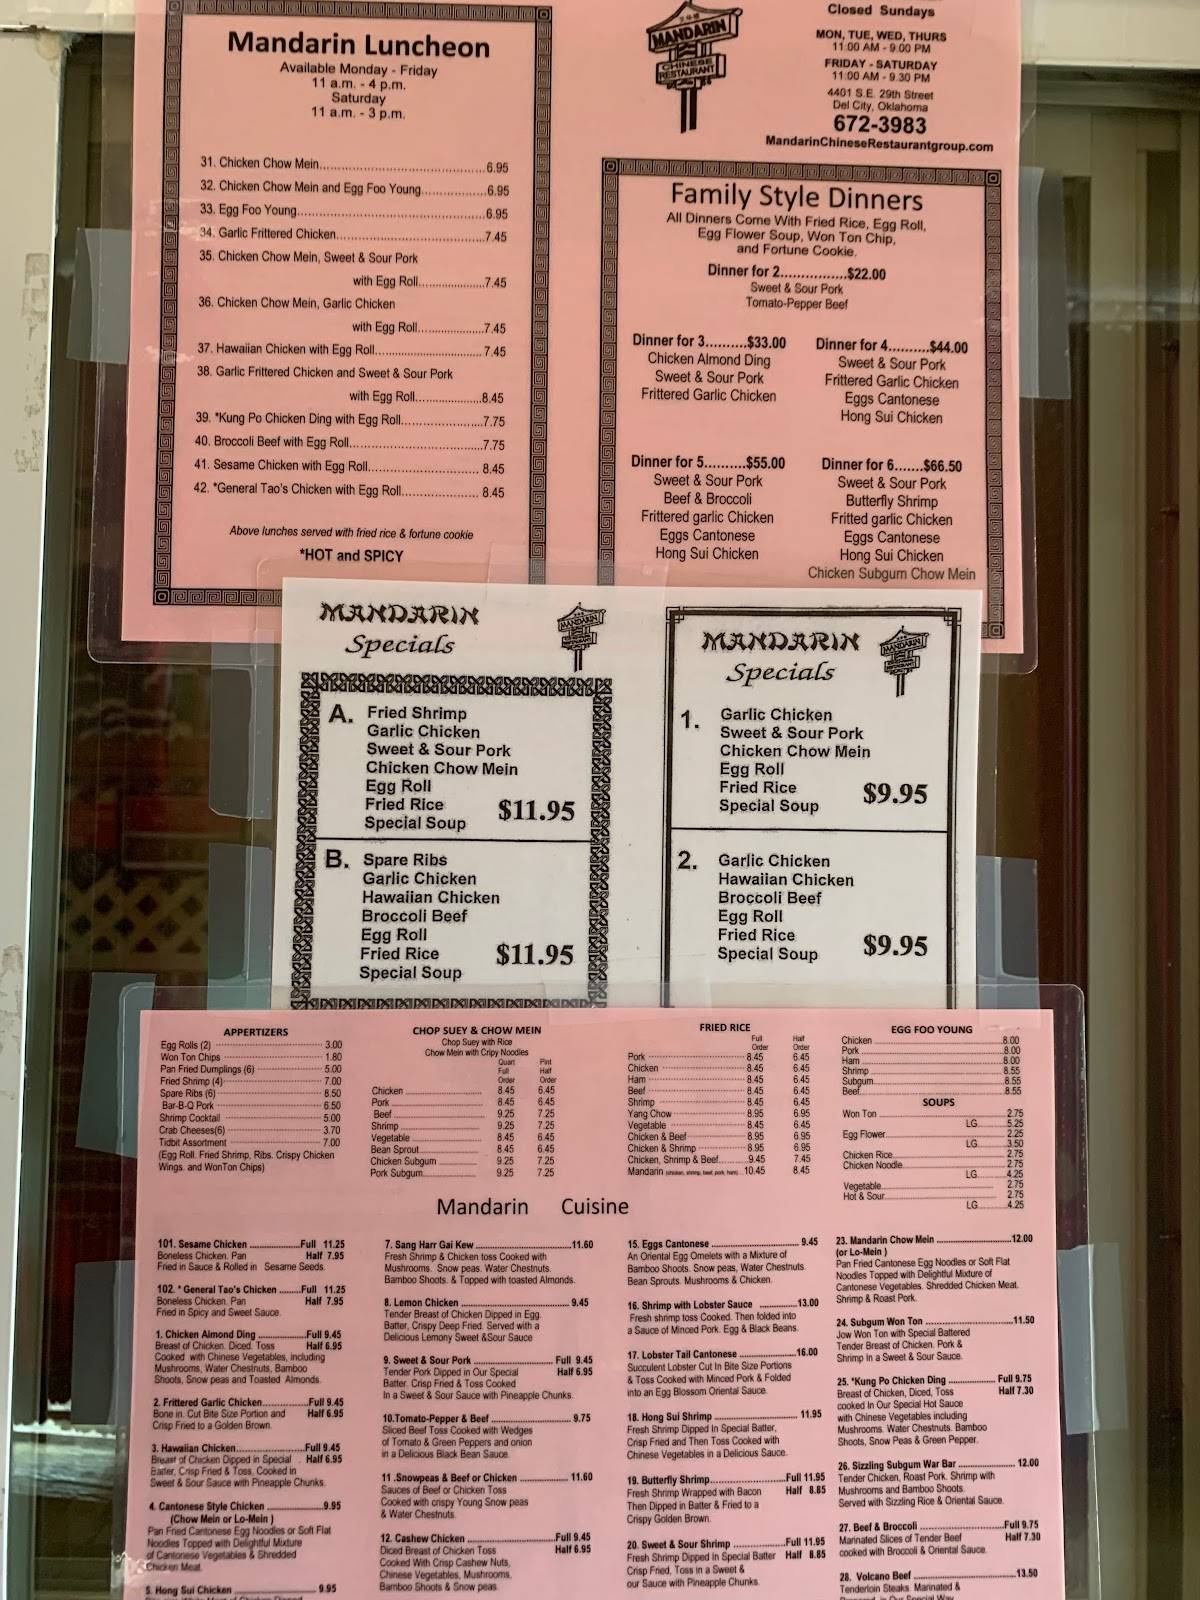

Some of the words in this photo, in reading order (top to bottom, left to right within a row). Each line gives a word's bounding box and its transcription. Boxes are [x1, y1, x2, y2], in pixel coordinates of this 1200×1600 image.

[828, 4, 872, 15] Closed
[880, 5, 935, 19] Sundays
[652, 19, 726, 48] MANDARIN
[816, 30, 845, 40] MON,
[848, 30, 873, 41] TUE,
[877, 31, 905, 42] WED,
[909, 32, 946, 42] THURS
[229, 31, 355, 54] Mandarin
[366, 34, 489, 58] Luncheon
[280, 62, 335, 74] Available
[340, 63, 387, 78] Monday
[401, 65, 437, 78] Friday
[661, 58, 713, 71] CHINESE
[825, 58, 866, 68] FRIDAY
[876, 60, 937, 70] SATURDAY
[658, 65, 715, 80] RESTAURANT
[313, 77, 324, 88] 11
[331, 80, 355, 88] a.m.
[369, 79, 376, 88] 4
[380, 81, 405, 92] p.m.
[332, 92, 386, 106] Saturday
[828, 88, 851, 97] 4401
[856, 88, 877, 98] S.E.
[880, 89, 900, 99] 29th
[904, 90, 933, 100] Street
[833, 100, 849, 110] Del
[852, 100, 874, 112] City,
[878, 101, 928, 112] Oklahoma
[834, 114, 926, 134] 672-3983
[766, 135, 993, 153] MandarinChineseRestaurantgroup.com
[672, 182, 751, 210] Family
[760, 185, 819, 212] Style
[830, 187, 922, 211] Dinners
[698, 227, 721, 241] Egg
[726, 228, 765, 240] Flower
[770, 230, 803, 243] Soup,
[808, 230, 835, 242] Won
[839, 232, 862, 242] Ton
[866, 232, 895, 246] Chip,
[200, 250, 214, 261] 35.
[218, 250, 258, 262] Chicken
[262, 250, 290, 262] Chow
[294, 251, 320, 264] Mein,
[324, 251, 354, 262] Sweet
[358, 252, 365, 263] &
[369, 252, 392, 263] Sour
[396, 252, 418, 264] Pork
[737, 244, 758, 254] and
[764, 244, 808, 255] Fortune
[813, 245, 856, 256] Cookie.
[199, 296, 213, 307] 36.
[218, 296, 257, 308] Chicken
[261, 297, 290, 308] Chow
[293, 297, 319, 310] Mein,
[323, 298, 352, 309] Garlic
[356, 298, 395, 309] Chicken
[746, 296, 822, 311] Tomato-Pepper
[826, 298, 848, 310] Beef
[648, 352, 694, 364] Chicken
[697, 353, 740, 366] Almond
[744, 354, 770, 369] Ding
[825, 373, 872, 387] Frittered
[876, 374, 910, 388] Garlic
[913, 376, 958, 389] Chicken
[846, 392, 874, 407] Eggs
[878, 392, 940, 406] Cantonese
[664, 492, 691, 504] Beef
[694, 492, 702, 504] &
[707, 492, 752, 505] Broccoli
[846, 494, 894, 510] Butterfly
[898, 495, 938, 510] Shrimp
[337, 550, 360, 561] and
[364, 550, 404, 562] SPICY
[808, 566, 854, 579] Chicken
[859, 567, 907, 582] Subgum
[911, 567, 944, 580] Chow
[948, 568, 976, 580] Mein
[320, 602, 479, 625] MANDARIN
[345, 634, 455, 658] Specials
[702, 632, 860, 651] MANDARIN
[726, 662, 835, 686] Specials
[328, 704, 353, 723] A.
[368, 706, 406, 718] Fried
[412, 706, 466, 723] Shrimp
[681, 710, 699, 728] 1.
[721, 708, 765, 720] Garlic
[771, 708, 832, 721] Chicken
[721, 726, 766, 738] Sweet
[772, 726, 782, 738] &
[788, 726, 824, 739] Sour
[829, 727, 864, 740] Pork
[366, 761, 428, 774] Chicken
[434, 762, 478, 774] Chow
[482, 762, 518, 775] Mein
[864, 782, 927, 804] $9.95
[499, 799, 574, 821] $11.95
[326, 849, 348, 868] B.
[364, 853, 408, 869] Spare
[414, 854, 447, 866] Ribs
[678, 850, 696, 869] 2.
[719, 872, 787, 886] Hawaiian
[792, 873, 854, 886] Chicken
[719, 891, 782, 904] Broccoli
[788, 892, 822, 904] Beef
[864, 934, 927, 956] $9.95
[497, 943, 573, 966] $11.95
[360, 966, 416, 982] Special
[422, 966, 462, 982] Soup
[224, 1028, 288, 1036] APPERTIZERS
[413, 1027, 440, 1035] CHOP
[470, 1026, 478, 1034] &
[481, 1026, 512, 1034] CHOW
[516, 1026, 541, 1034] MEIN
[730, 1024, 750, 1032] RICE
[892, 1026, 911, 1034] EGG
[914, 1026, 934, 1034] FOO
[937, 1026, 972, 1034] YOUNG
[326, 1040, 342, 1049] 3.00
[442, 1038, 460, 1047] Chop
[462, 1038, 480, 1048] Suey
[482, 1038, 495, 1046] with
[497, 1038, 512, 1046] Rice
[923, 1098, 955, 1106] SOUPS
[498, 1121, 514, 1130] 9.25
[793, 1166, 810, 1174] 8.45
[1008, 1180, 1024, 1188] 2.75
[438, 1198, 528, 1215] Mandarin
[562, 1198, 628, 1214] Cuisine
[384, 1298, 391, 1306] 8.
[394, 1298, 422, 1306] Lemon
[425, 1298, 458, 1307] Chicken
[837, 1318, 848, 1327] 24.
[850, 1318, 884, 1328] Subgum
[886, 1317, 905, 1326] Won
[908, 1317, 922, 1325] Ton
[627, 1489, 649, 1498] Fresh
[652, 1488, 679, 1498] Shrimp
[682, 1488, 717, 1498] Wrapped
[719, 1488, 734, 1496] with
[737, 1487, 762, 1496] Bacon
[381, 1533, 392, 1542] 12.
[395, 1534, 428, 1543] Cashew
[431, 1534, 464, 1543] Chicken
[840, 1572, 851, 1582] 28.
[856, 1572, 890, 1581] Volcano
[893, 1570, 911, 1580] Beef
